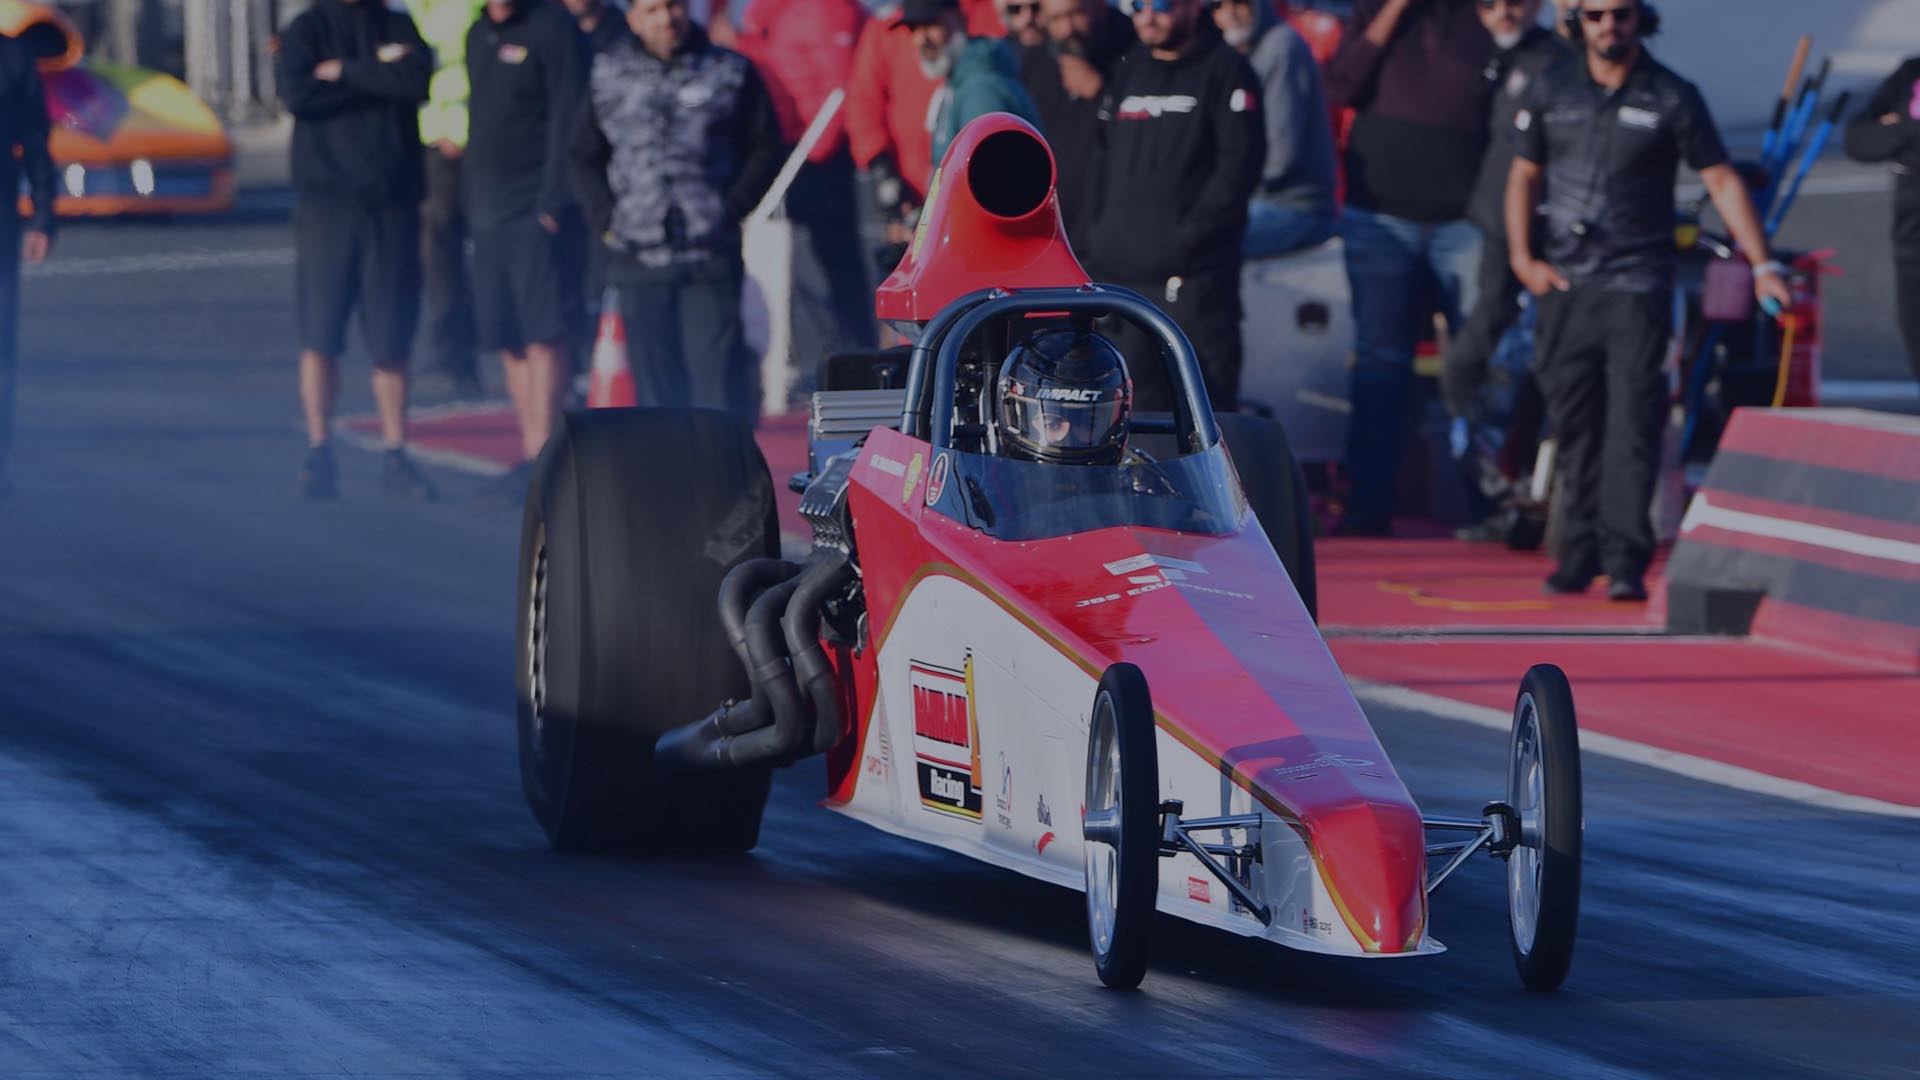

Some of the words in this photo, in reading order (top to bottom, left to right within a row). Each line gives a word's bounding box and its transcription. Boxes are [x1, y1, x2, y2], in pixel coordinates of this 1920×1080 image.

[1036, 388, 1102, 401] IMPACT
[1075, 593, 1122, 608] JBS
[1127, 580, 1254, 600] EQUIPMENT
[930, 768, 965, 807] Racing
